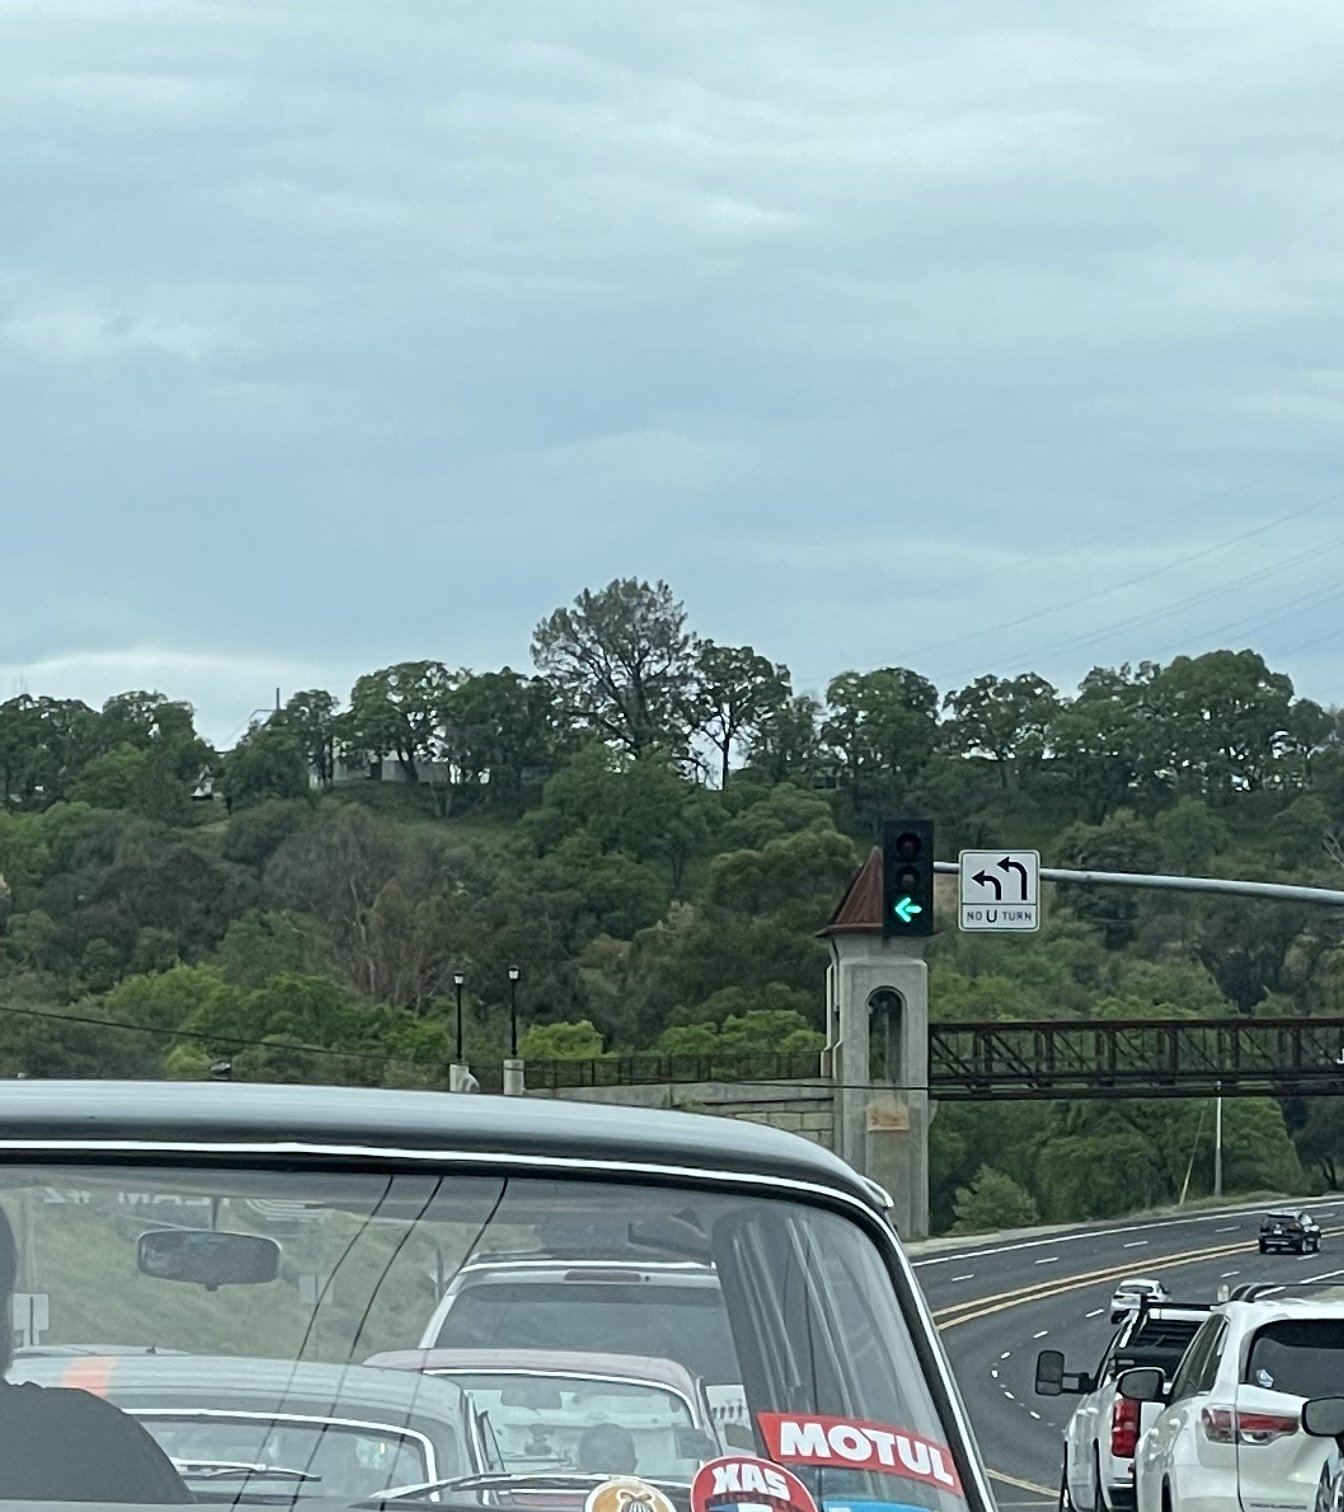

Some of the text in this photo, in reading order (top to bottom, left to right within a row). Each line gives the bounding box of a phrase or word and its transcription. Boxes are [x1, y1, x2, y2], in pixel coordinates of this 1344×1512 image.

[966, 909, 1032, 923] NO U TURN
[780, 1420, 955, 1488] MOTUL
[711, 1463, 791, 1501] XAS
